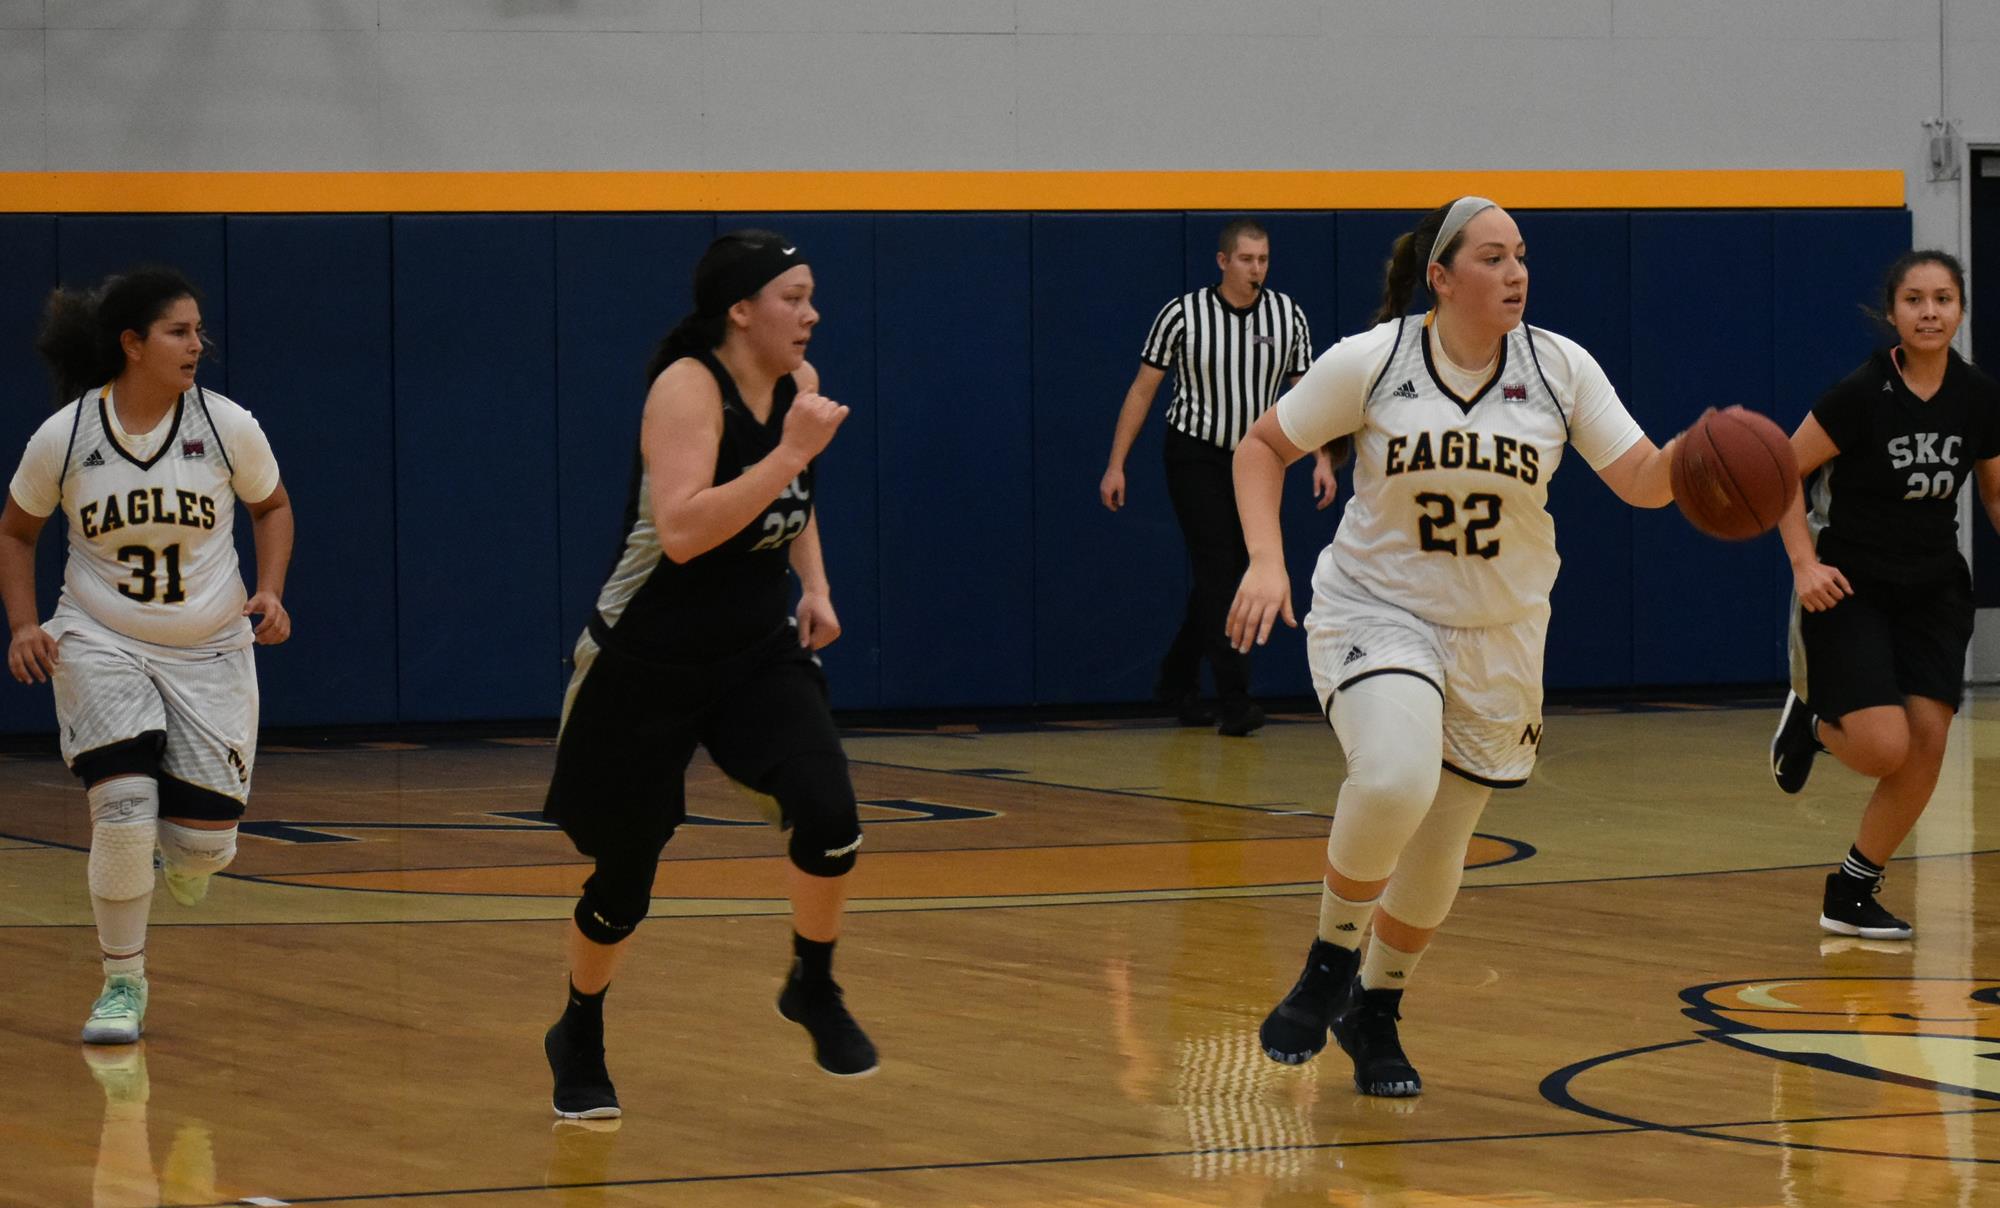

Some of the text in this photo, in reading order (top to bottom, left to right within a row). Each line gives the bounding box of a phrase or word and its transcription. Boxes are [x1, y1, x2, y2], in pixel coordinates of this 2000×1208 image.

[1385, 430, 1539, 486] EAGLES
[1888, 433, 1962, 469] SKC
[1904, 471, 1955, 500] 20
[80, 488, 216, 539] EAGLES
[1414, 492, 1503, 560] 22
[117, 543, 186, 604] 31
